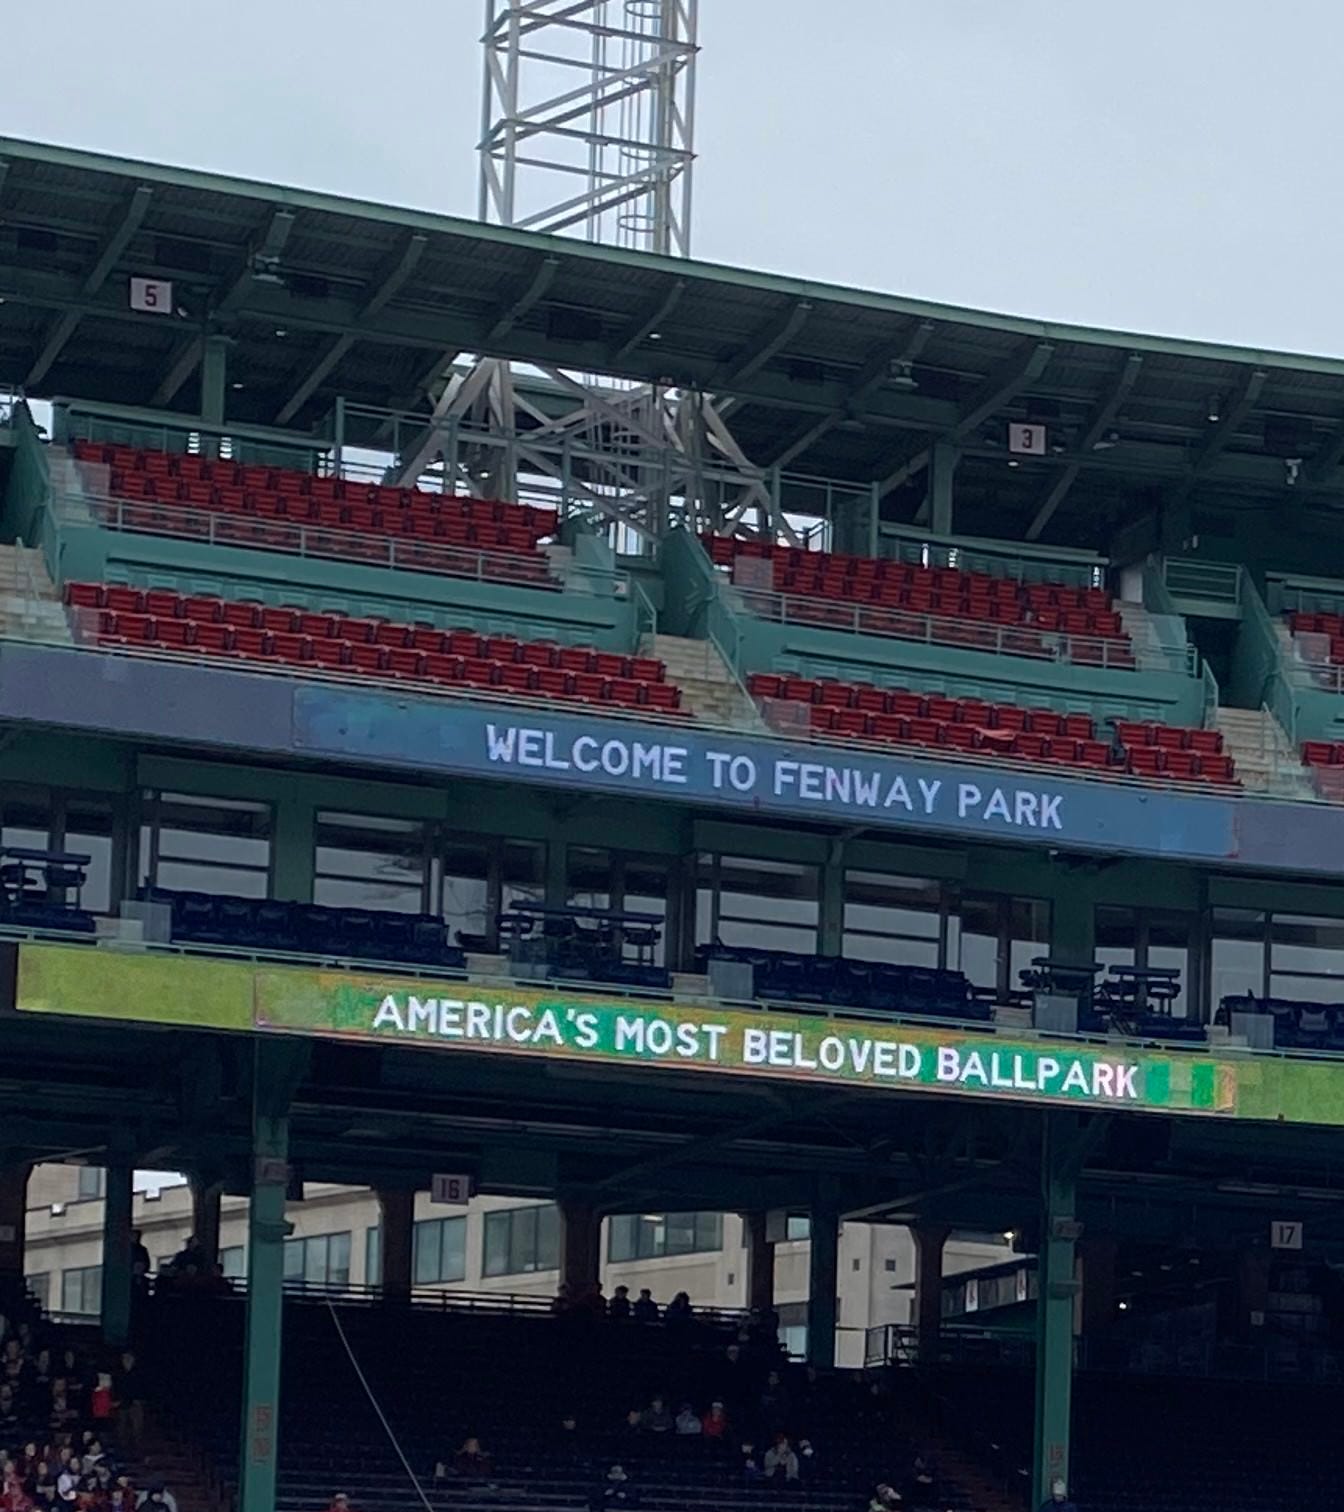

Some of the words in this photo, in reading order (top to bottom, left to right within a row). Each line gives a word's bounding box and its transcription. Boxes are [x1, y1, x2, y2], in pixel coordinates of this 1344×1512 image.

[144, 284, 158, 307] 5
[1022, 428, 1033, 450] 3
[486, 724, 687, 783] WELCOME
[706, 752, 756, 791] TO
[774, 761, 942, 814] FENWAY
[958, 783, 1063, 829] PARK
[373, 995, 599, 1048] AMERICA'S
[615, 1015, 727, 1060] MOST
[743, 1028, 921, 1078] BELOVED
[937, 1046, 1138, 1098] BALLPARK
[440, 1178, 459, 1201] 16
[1280, 1225, 1296, 1246] 17
